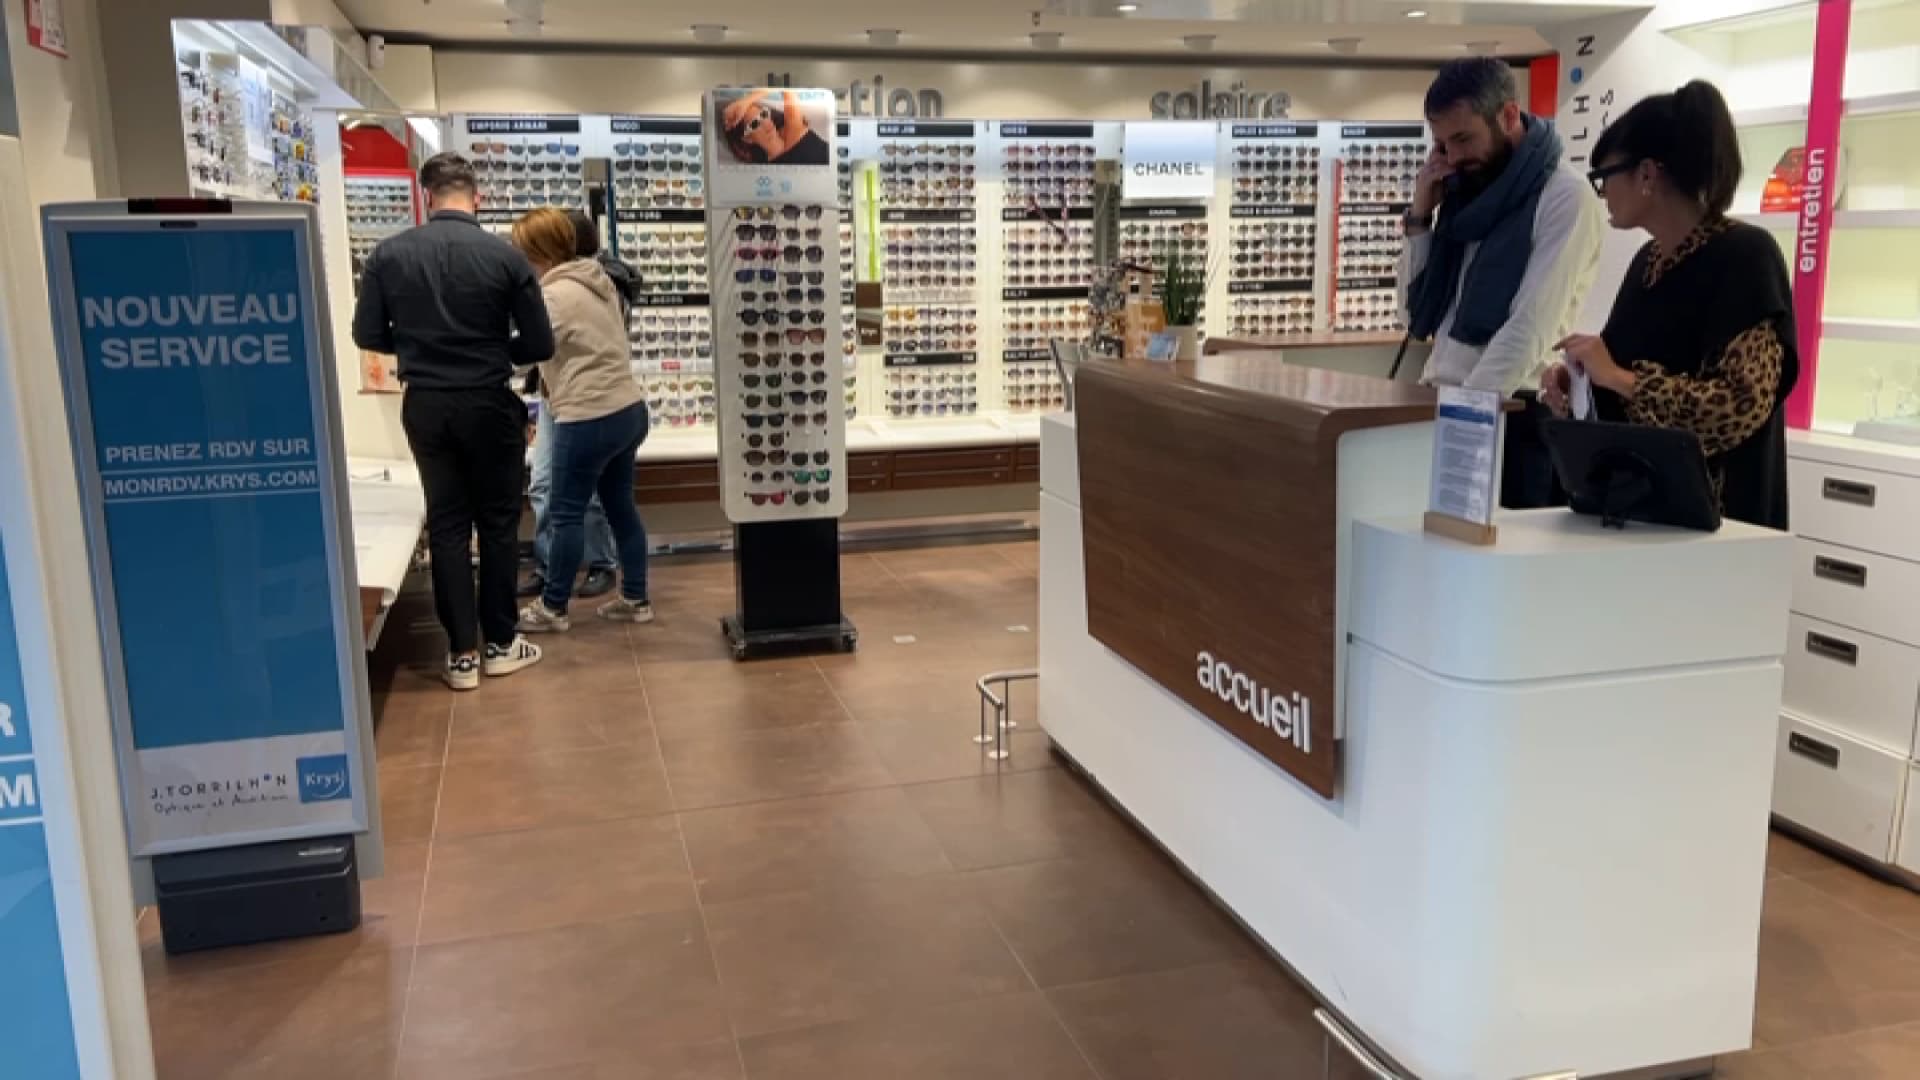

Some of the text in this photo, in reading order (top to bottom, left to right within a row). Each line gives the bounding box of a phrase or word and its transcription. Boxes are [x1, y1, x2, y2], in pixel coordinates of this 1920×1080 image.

[1134, 162, 1204, 176] CHANEL
[1799, 148, 1825, 273] entretien
[83, 293, 298, 328] NOUVEAU
[100, 334, 292, 369] SERVICE
[106, 438, 311, 463] PRENEZ RDV SUR
[105, 470, 317, 495] MONRDV.KRYS.COM
[1196, 650, 1312, 755] accueil
[0, 704, 15, 736] R
[0, 774, 35, 808] M
